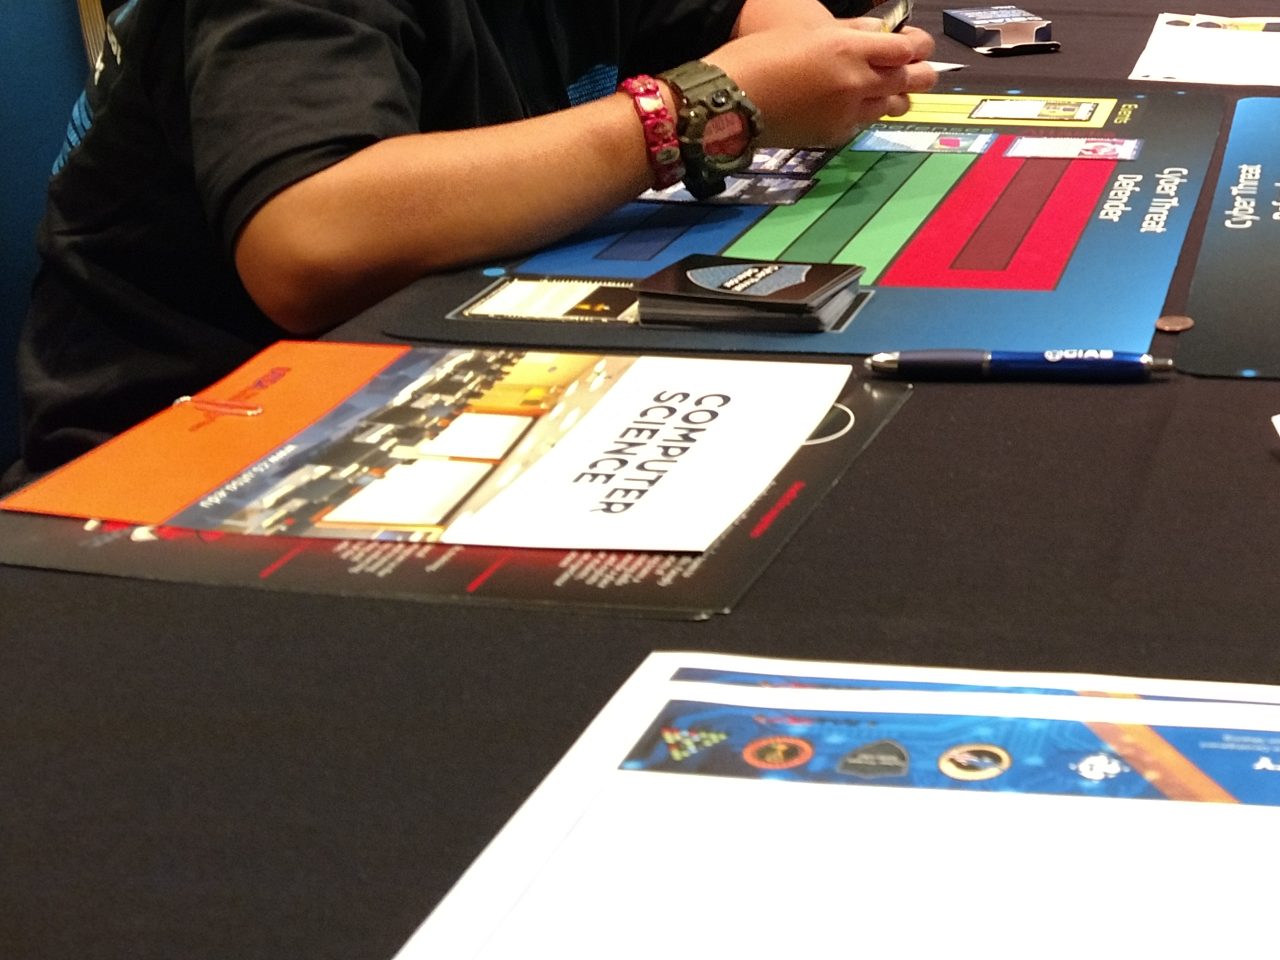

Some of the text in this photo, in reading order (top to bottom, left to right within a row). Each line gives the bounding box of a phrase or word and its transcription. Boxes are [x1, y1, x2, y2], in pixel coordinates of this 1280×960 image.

[1099, 174, 1143, 222] Defender
[1140, 167, 1189, 233] Cyber Threat
[1224, 164, 1262, 228] Cyber Threat
[572, 390, 690, 485] SCIENCE
[589, 393, 731, 514] COMPUTER
